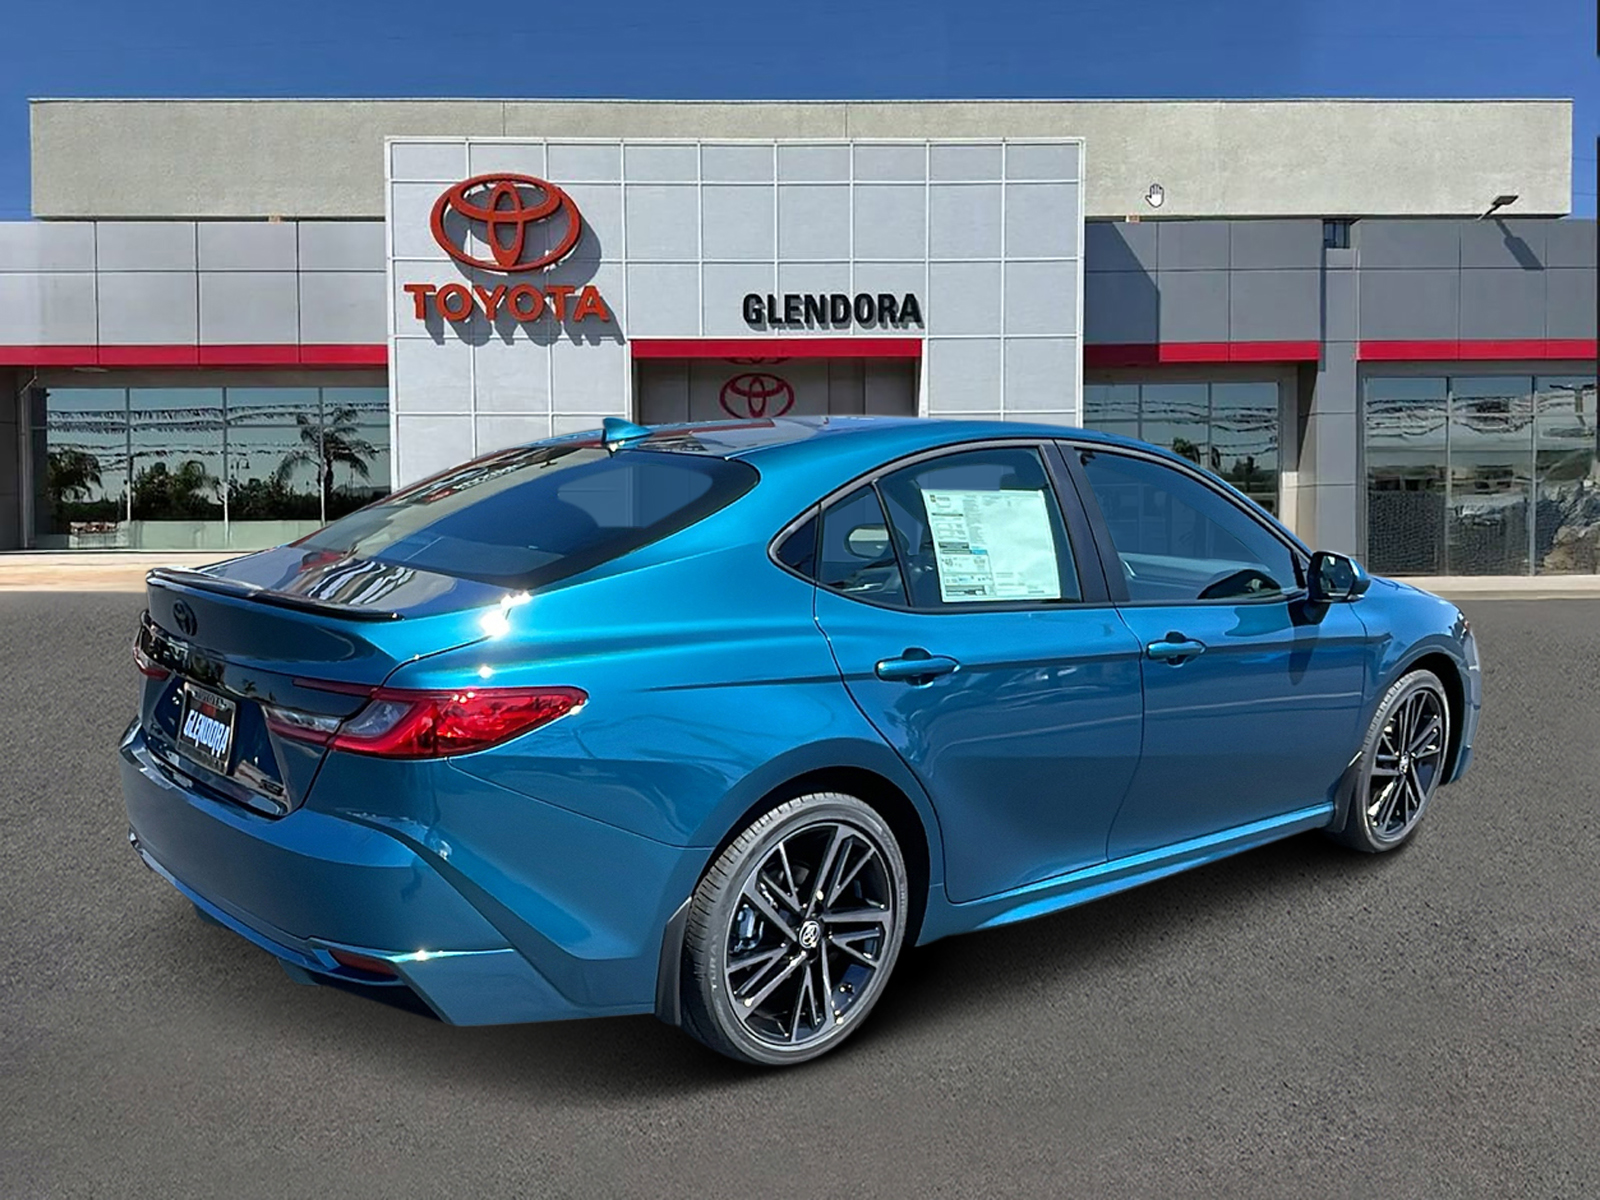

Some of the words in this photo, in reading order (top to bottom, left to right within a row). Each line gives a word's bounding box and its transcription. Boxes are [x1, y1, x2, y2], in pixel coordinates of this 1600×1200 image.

[404, 283, 610, 322] TOYOTA
[743, 293, 924, 325] GLENDORA
[183, 709, 230, 757] GLENDORA
